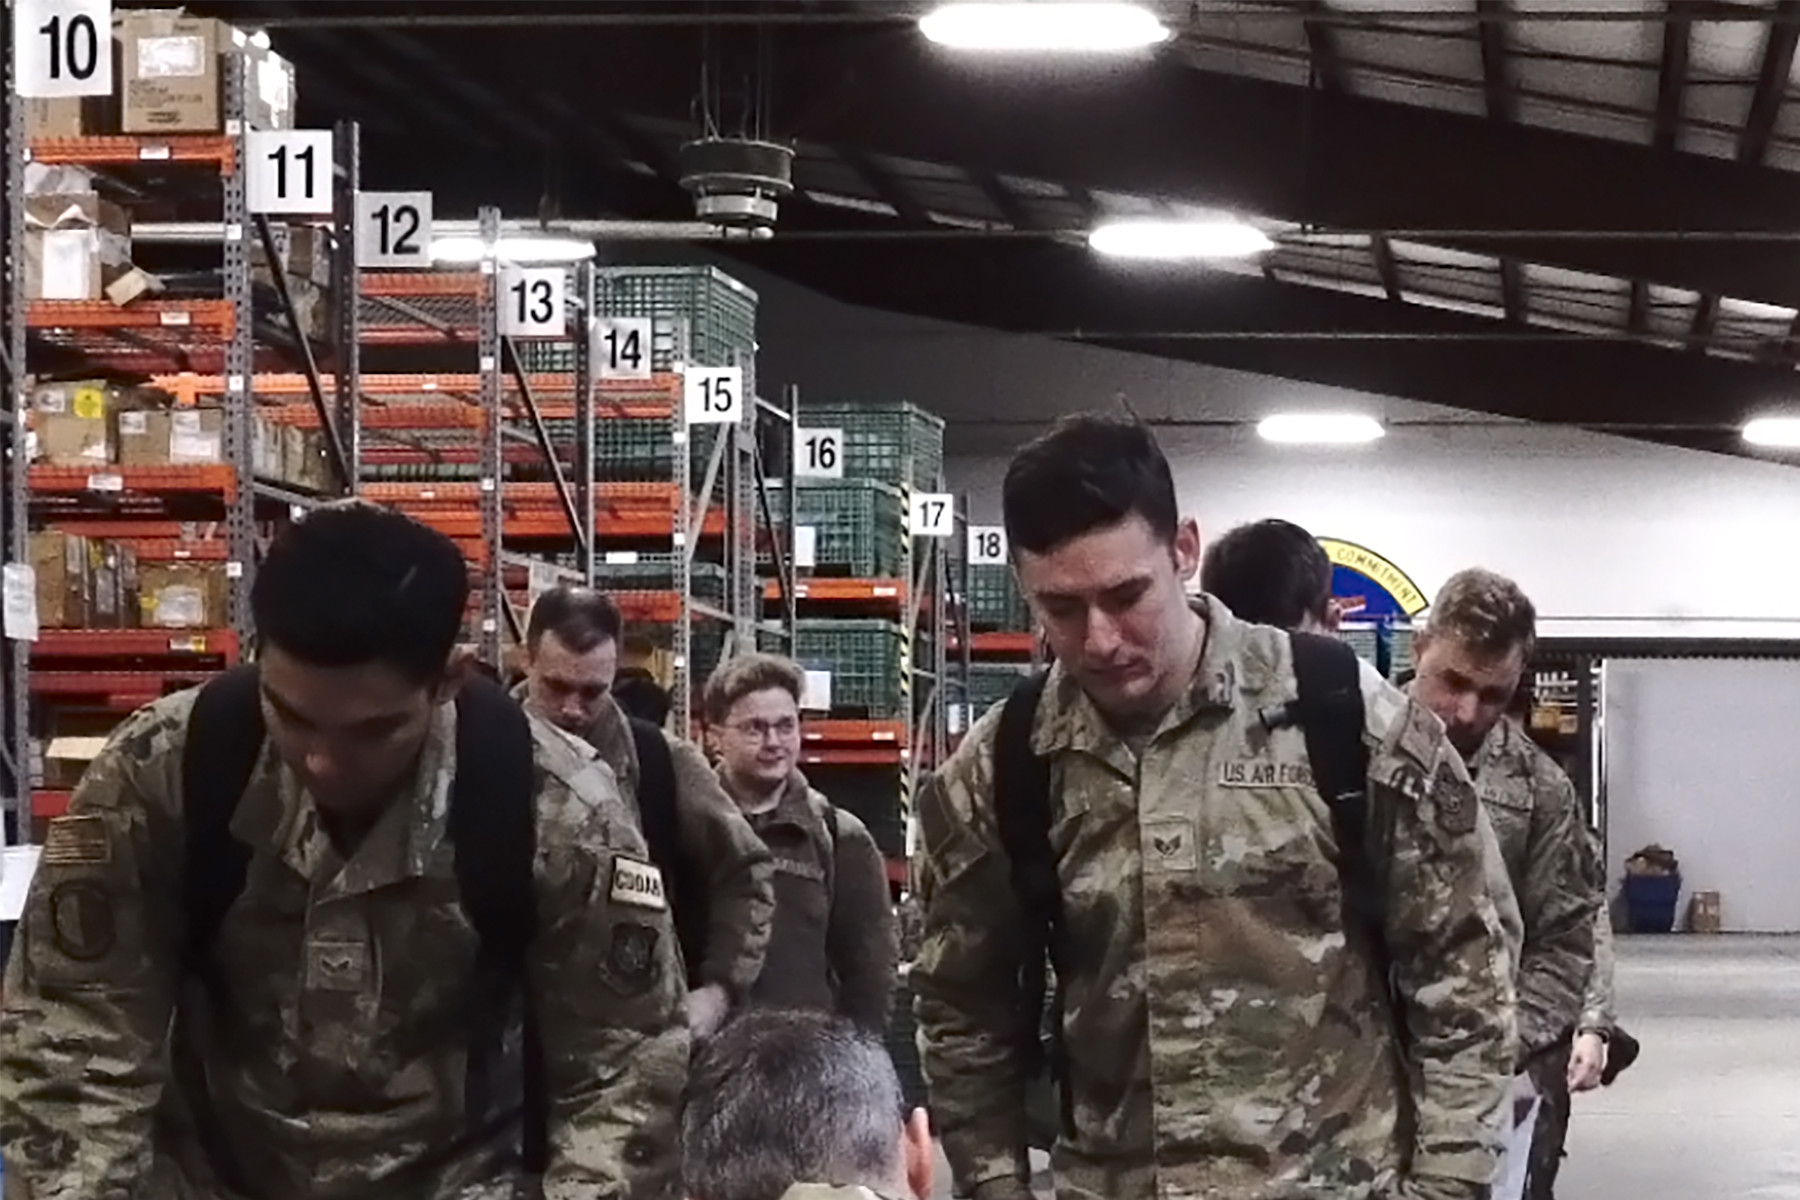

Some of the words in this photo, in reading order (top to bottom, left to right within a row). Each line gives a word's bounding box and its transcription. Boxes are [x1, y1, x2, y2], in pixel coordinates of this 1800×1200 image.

[39, 14, 98, 81] 10
[267, 144, 315, 199] 11
[370, 203, 421, 256] 12
[510, 279, 553, 324] 13
[603, 328, 642, 370] 14
[697, 376, 732, 412] 15
[804, 436, 836, 470] 16
[917, 501, 945, 527] 17
[975, 532, 1001, 558] 18
[1336, 548, 1417, 604] COMMITMENT
